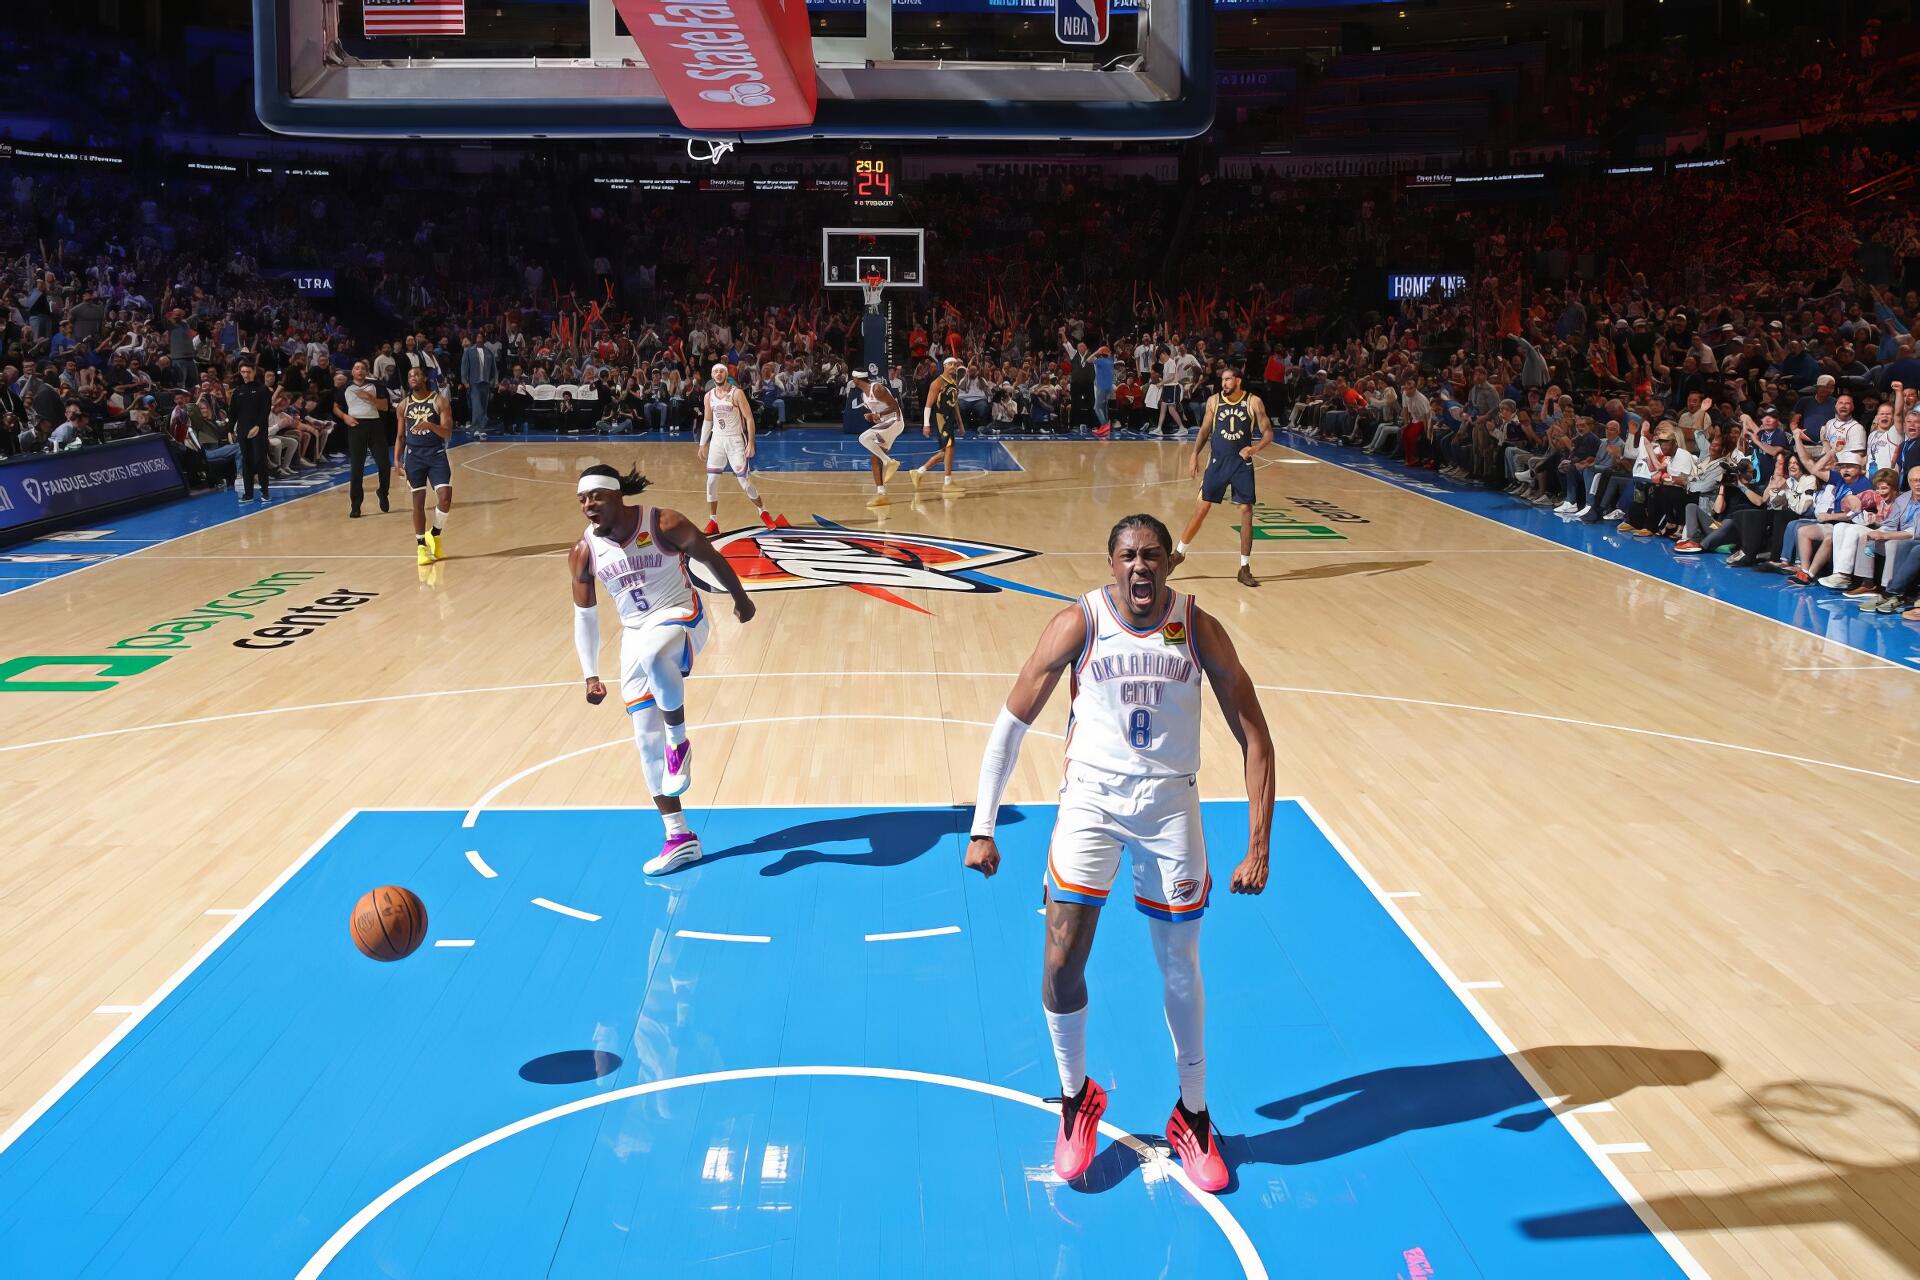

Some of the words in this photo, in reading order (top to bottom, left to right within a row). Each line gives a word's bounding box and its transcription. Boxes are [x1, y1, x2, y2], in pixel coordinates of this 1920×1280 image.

[1063, 16, 1088, 36] NBA
[858, 172, 891, 196] 24
[293, 278, 332, 289] LTRA
[1229, 416, 1235, 432] 1
[42, 474, 93, 497] FANDUEL
[90, 466, 128, 486] SPORTS
[106, 570, 326, 649] paycom
[629, 588, 650, 611] 5
[232, 588, 380, 650] center
[1090, 652, 1193, 683] OKLAHOMA
[1121, 680, 1166, 706] CITY
[1129, 707, 1153, 750] 8
